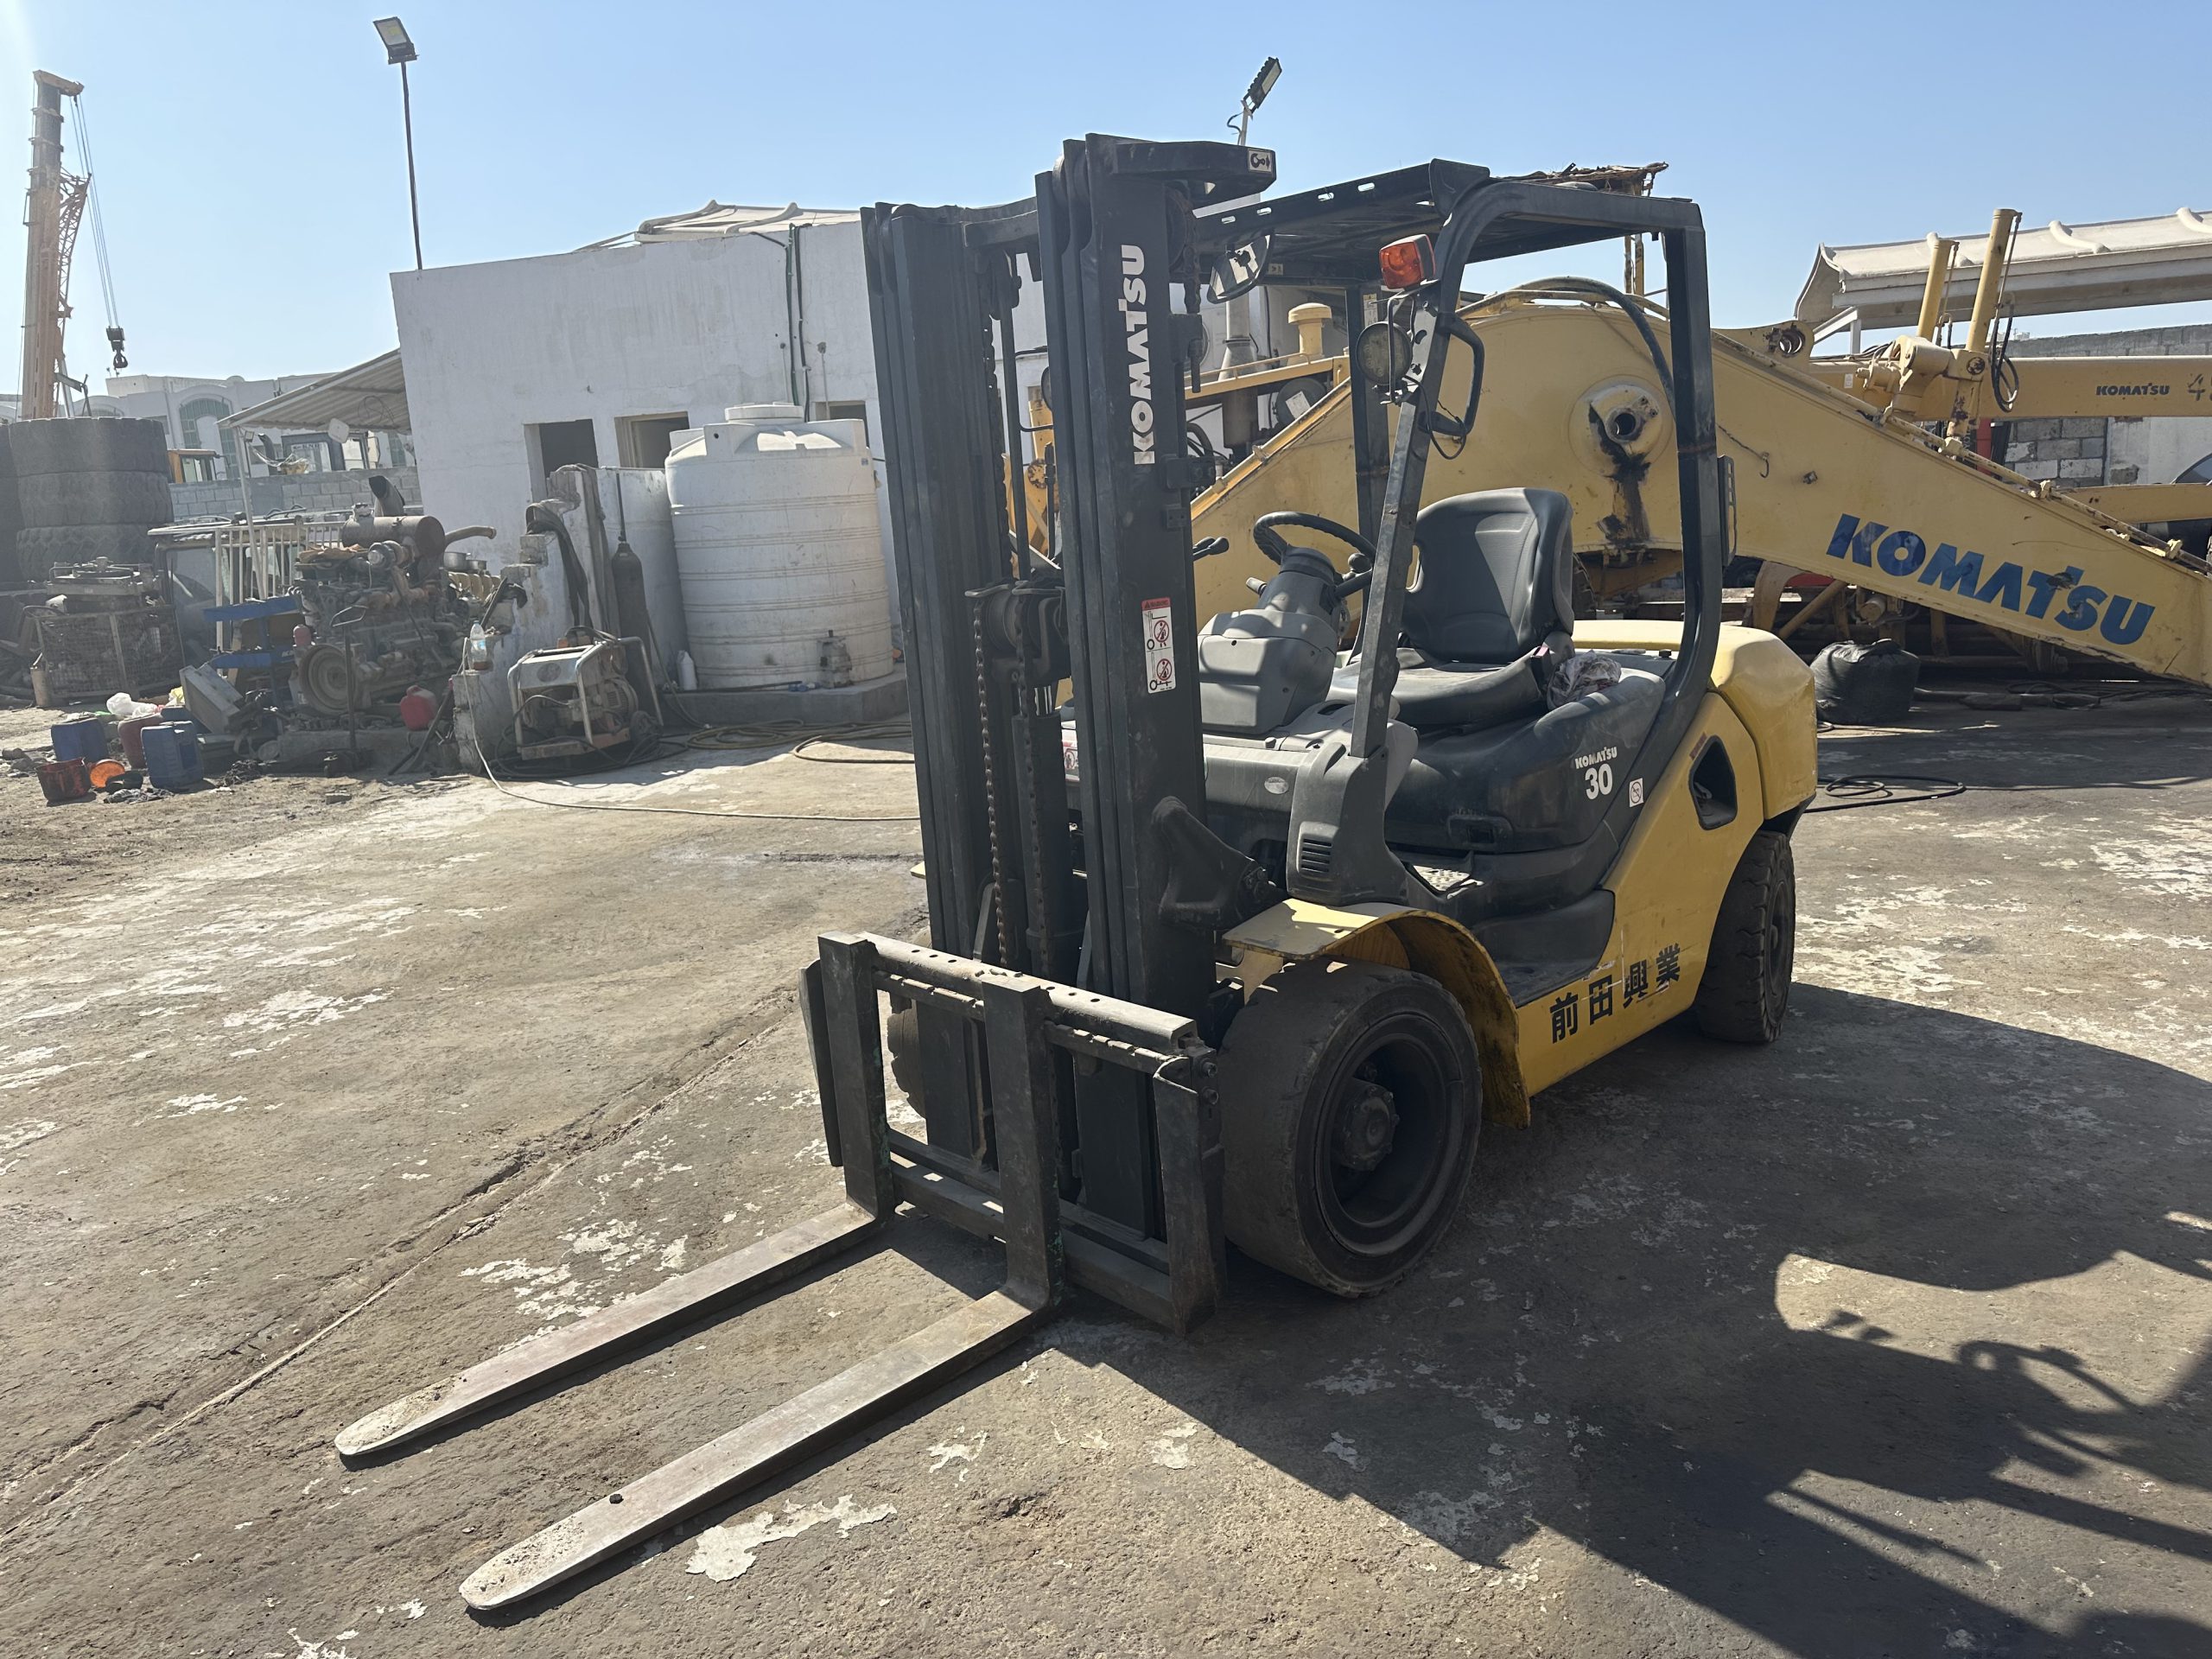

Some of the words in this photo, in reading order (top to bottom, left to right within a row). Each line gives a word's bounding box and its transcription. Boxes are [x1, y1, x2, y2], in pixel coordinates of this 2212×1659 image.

[1118, 245, 1155, 465] KOMATSU
[2095, 383, 2171, 396] KOMATSU
[1826, 513, 2156, 645] KOMATSU
[1574, 746, 1618, 770] KOMATSU
[1584, 763, 1613, 800] 30
